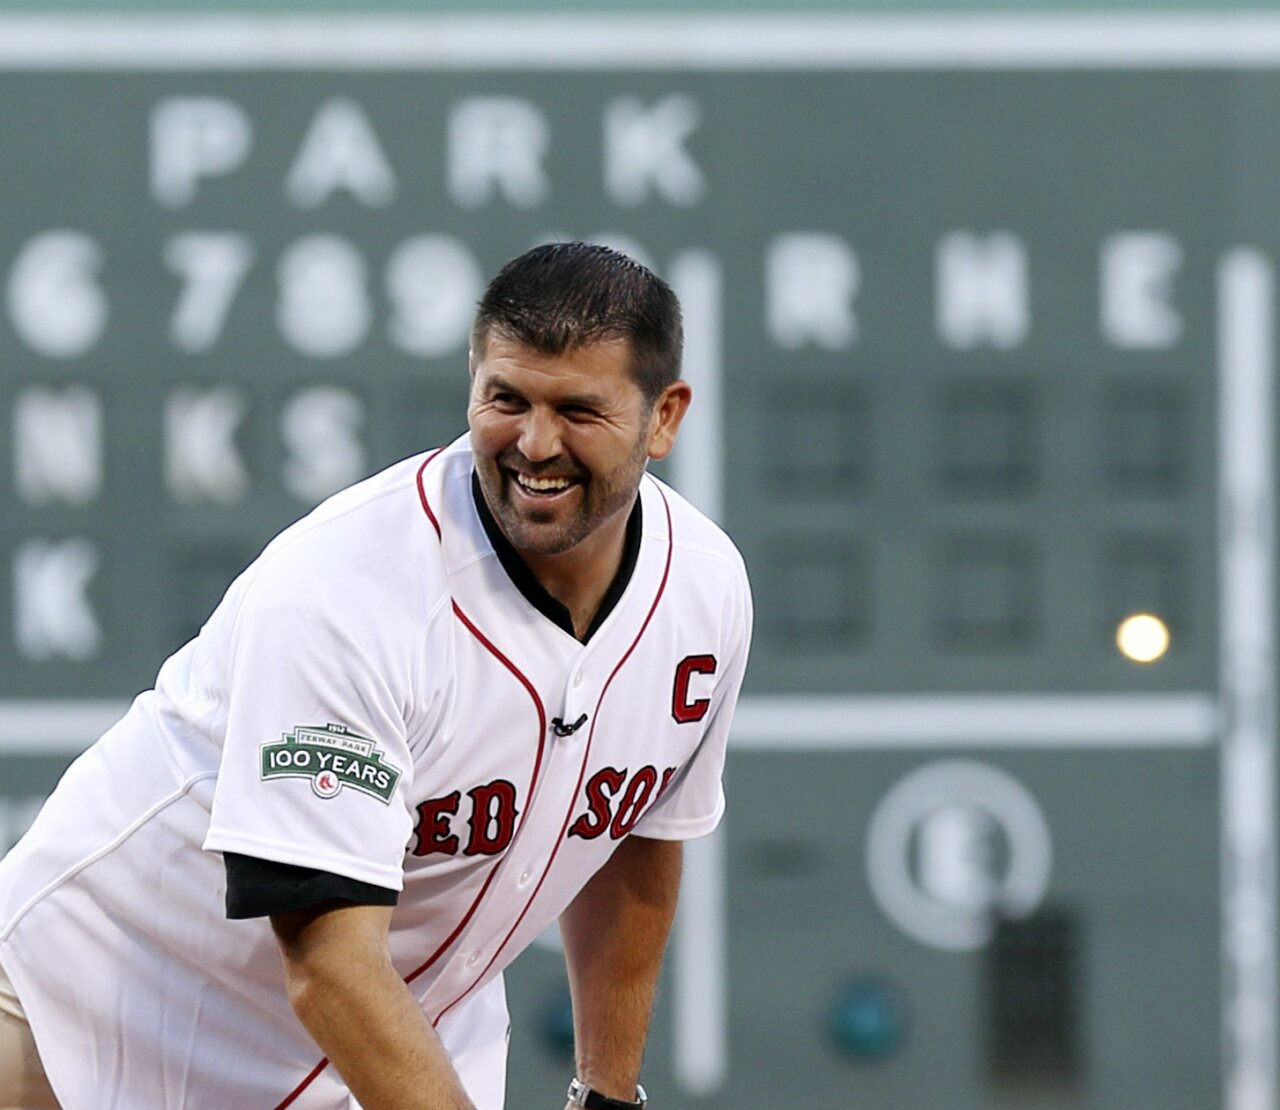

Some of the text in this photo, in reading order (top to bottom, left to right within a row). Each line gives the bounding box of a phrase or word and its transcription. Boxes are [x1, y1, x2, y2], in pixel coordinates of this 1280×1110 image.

[148, 95, 705, 207] PARK
[4, 230, 108, 358] 6
[165, 231, 253, 354] 7
[276, 233, 371, 358] 8
[386, 233, 484, 358] 9
[765, 231, 860, 350] R
[934, 230, 1031, 350] H
[1099, 230, 1183, 350] E
[672, 654, 717, 724] C
[270, 750, 391, 789] 100 YEARS
[300, 734, 367, 753] FENWAY PARK
[405, 779, 518, 856] ED
